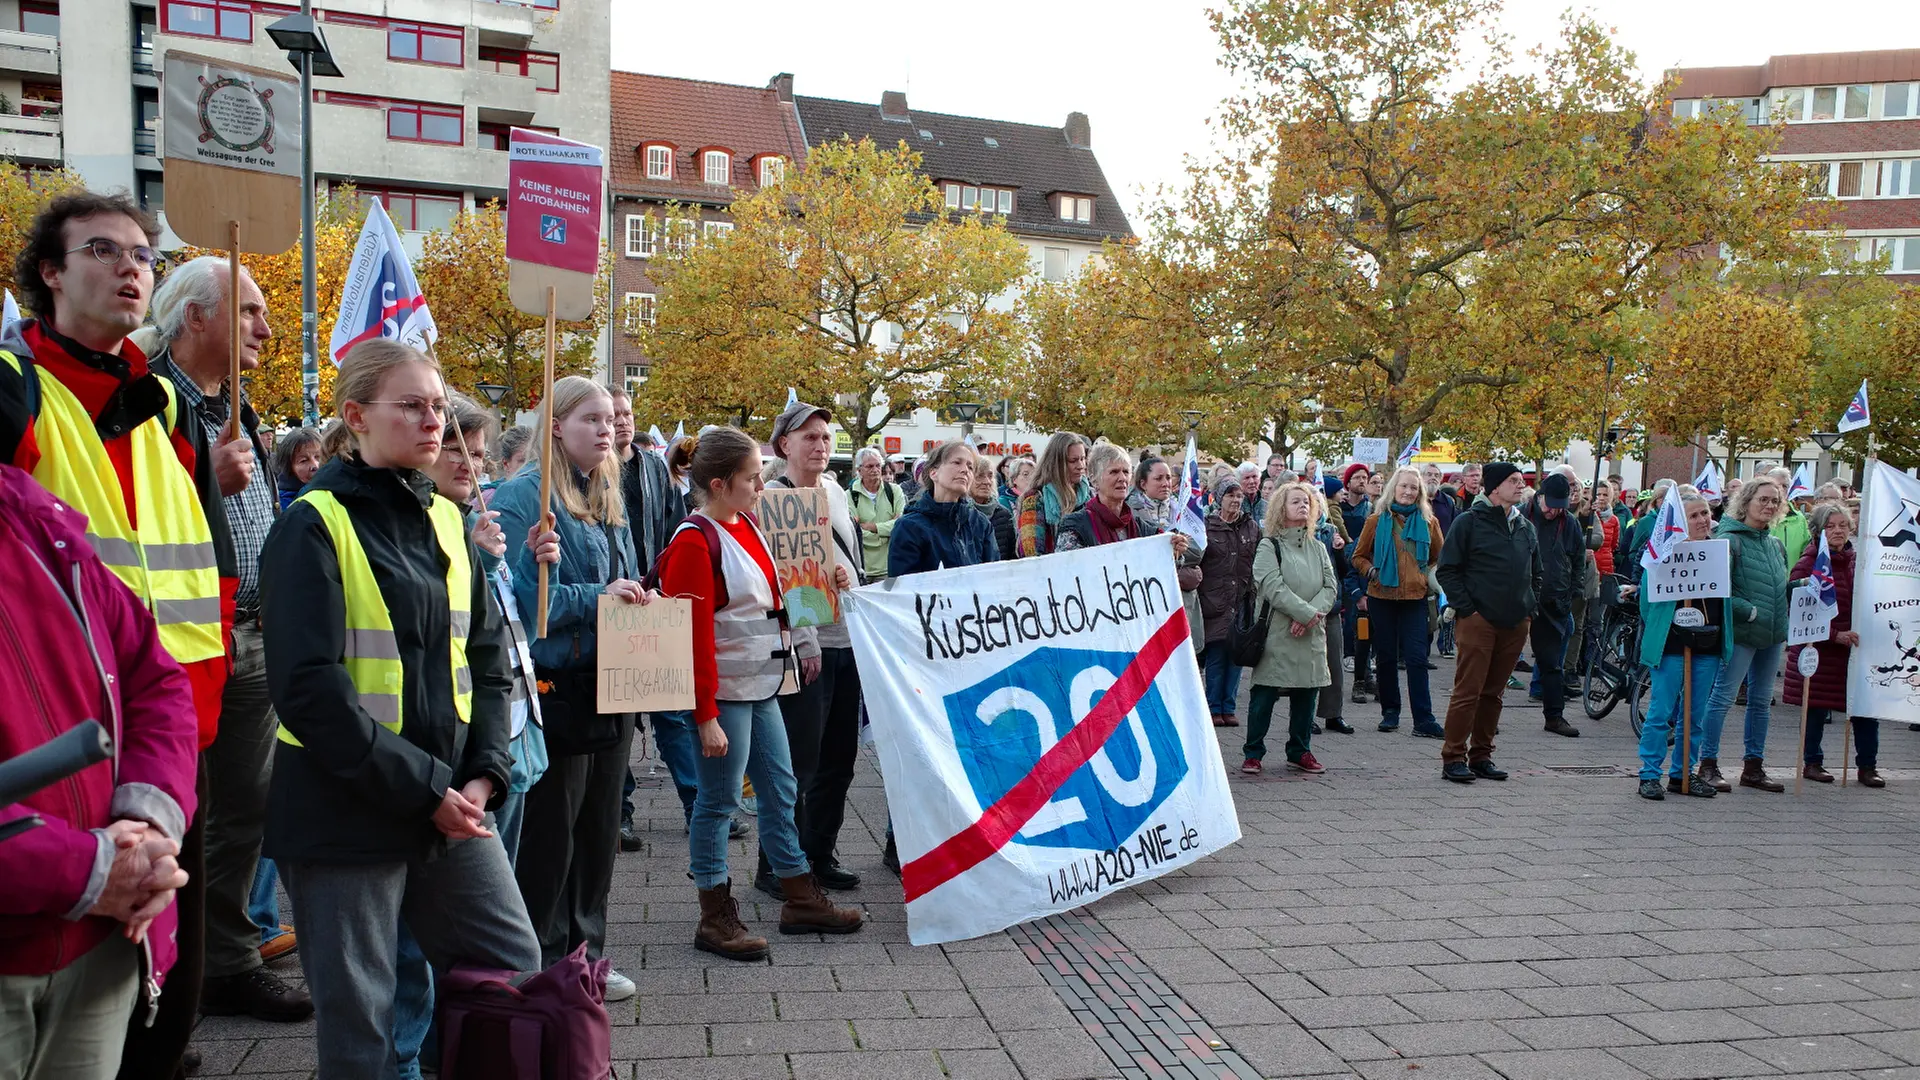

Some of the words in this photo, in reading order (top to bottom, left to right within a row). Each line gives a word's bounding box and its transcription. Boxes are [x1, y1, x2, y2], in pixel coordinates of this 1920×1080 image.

[197, 147, 242, 163] Weissagung
[245, 155, 257, 164] der
[260, 158, 275, 167] Cree
[515, 147, 537, 156] ROTE
[539, 149, 590, 160] KLIMAKARTE
[519, 179, 552, 194] KEINE
[554, 187, 591, 202] NEUEN
[519, 192, 590, 214] AUTOBAHNEN
[761, 492, 817, 531] NOW
[818, 516, 828, 526] or
[764, 529, 826, 565] NEVER
[1670, 568, 1698, 578] for
[1656, 582, 1717, 594] future
[1874, 598, 1920, 614] Power
[1793, 625, 1825, 638] future
[627, 635, 659, 654] STATT
[976, 664, 1158, 838] 20
